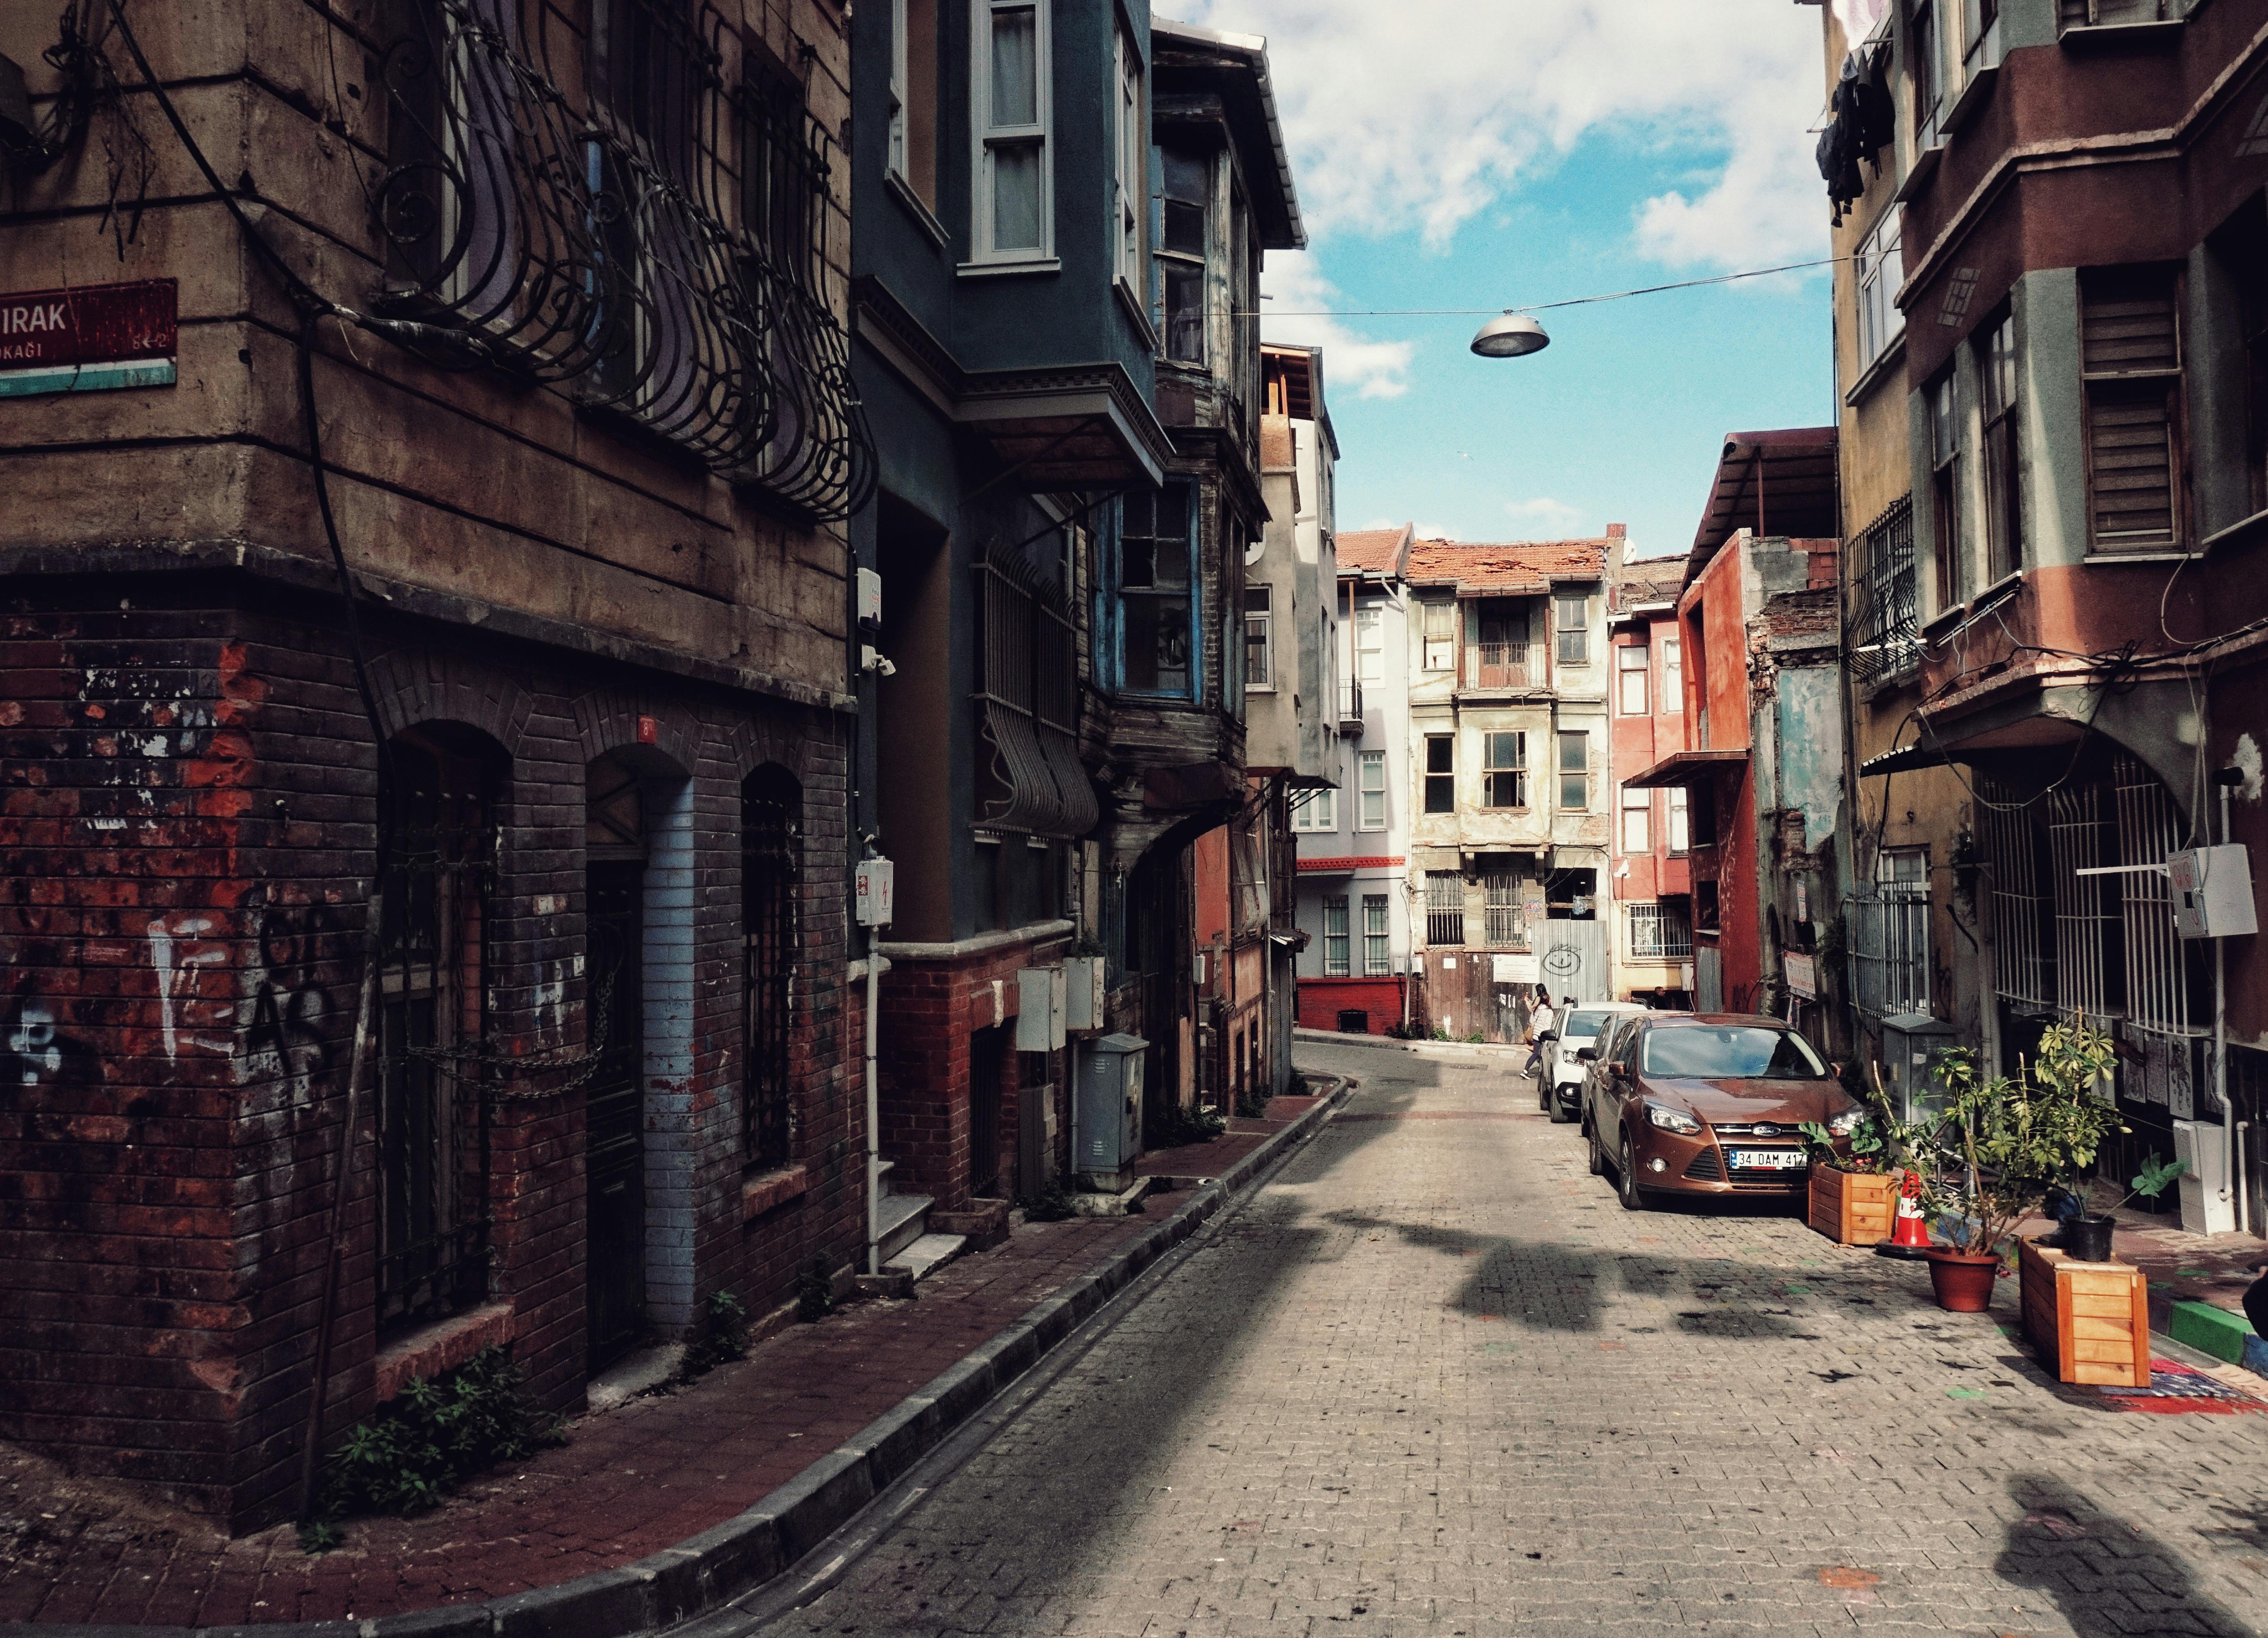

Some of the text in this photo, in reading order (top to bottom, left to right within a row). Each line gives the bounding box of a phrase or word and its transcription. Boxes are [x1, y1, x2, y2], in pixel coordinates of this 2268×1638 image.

[0, 341, 41, 360] KAĞI
[1739, 1153, 1804, 1165] 34 DAM 417
